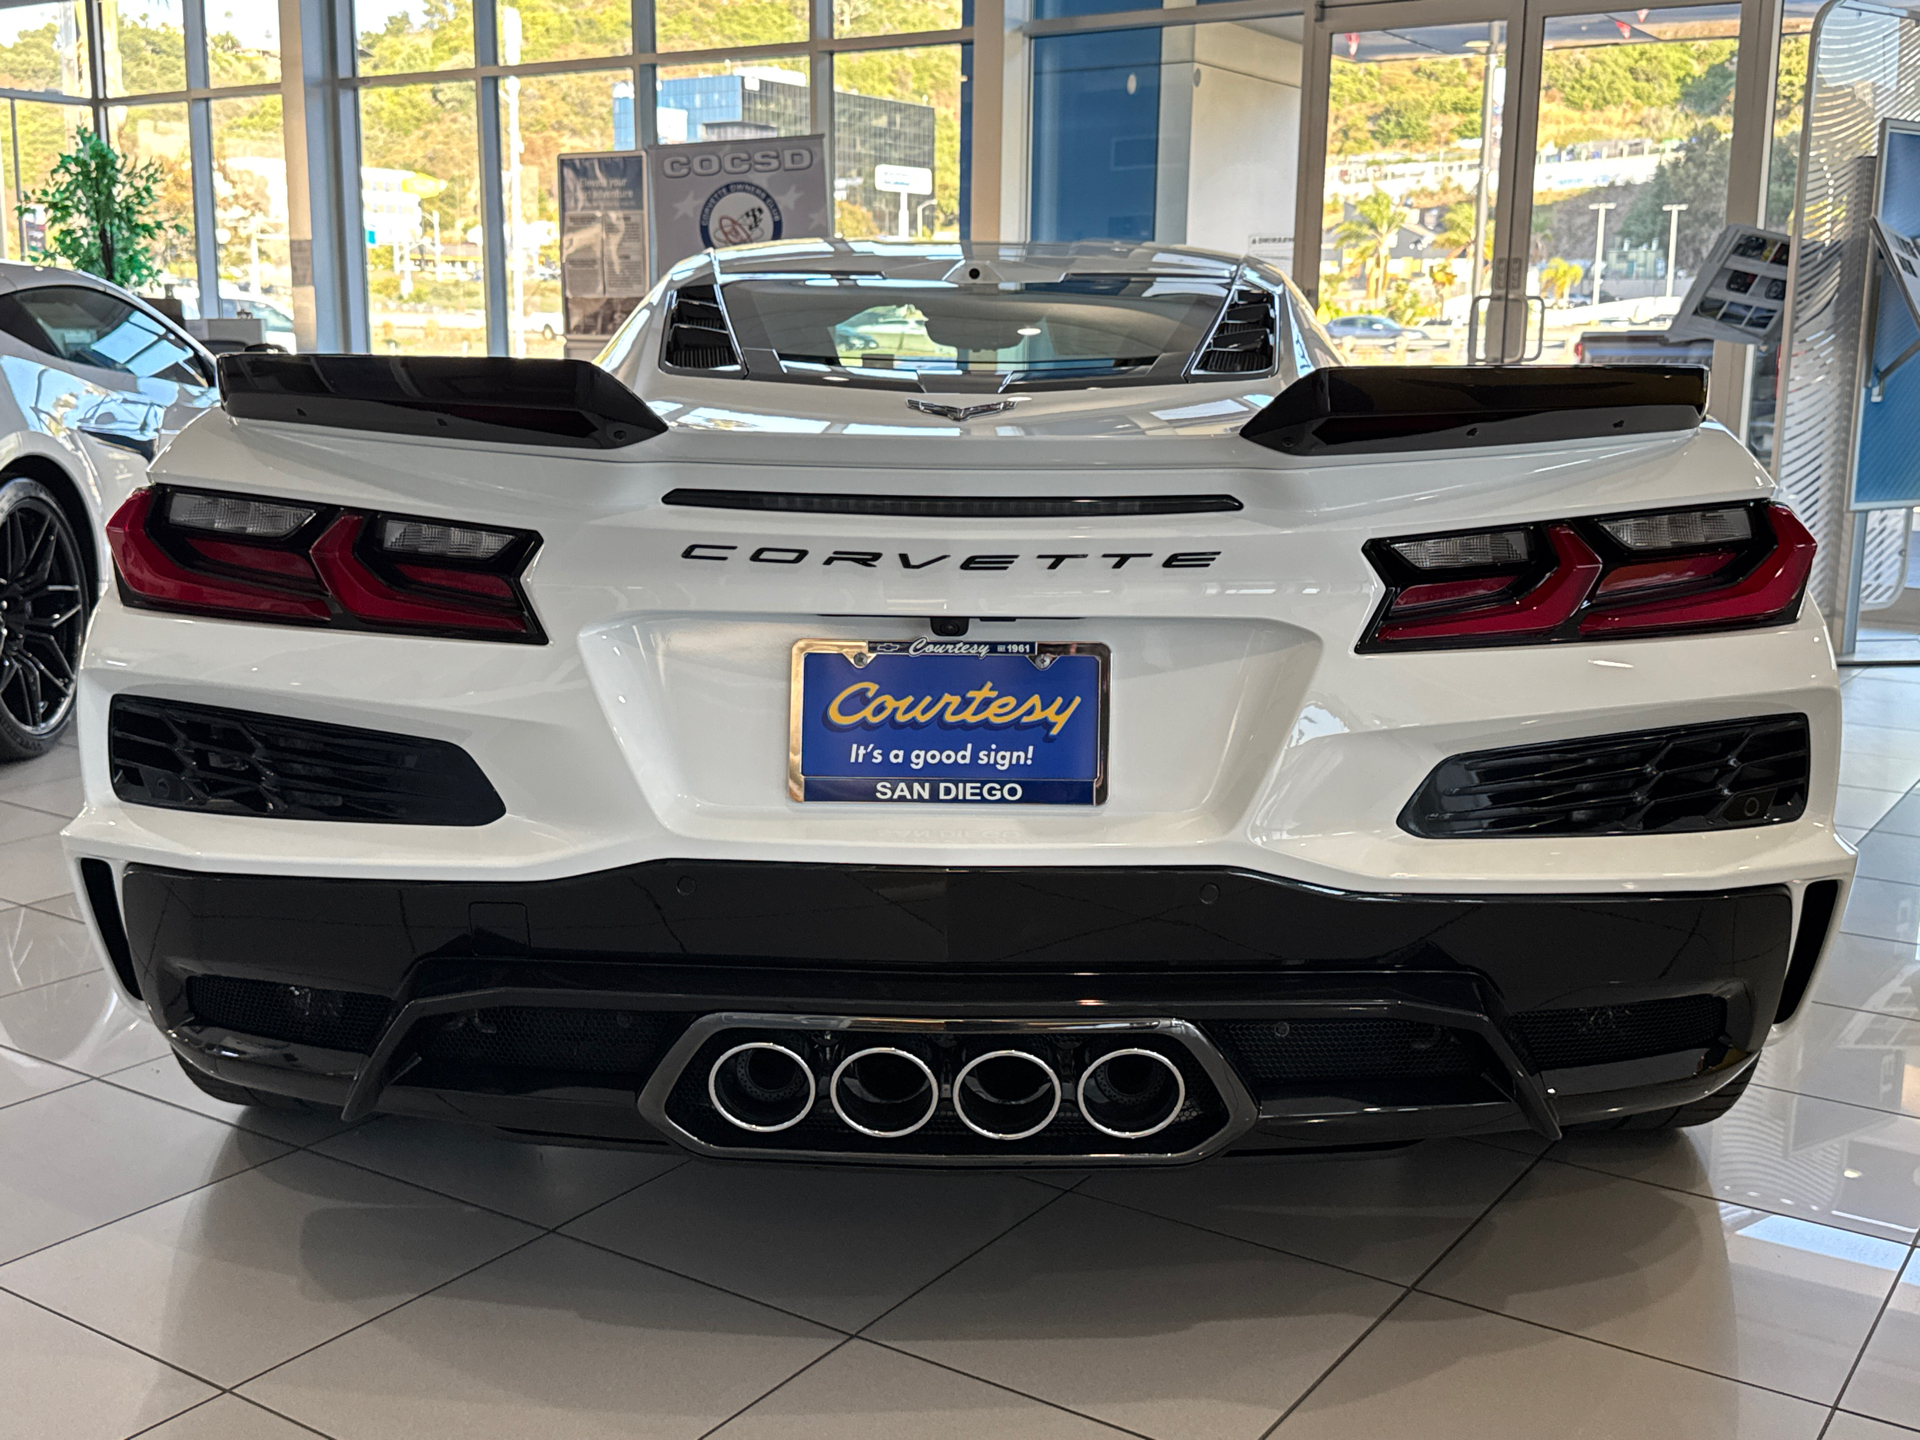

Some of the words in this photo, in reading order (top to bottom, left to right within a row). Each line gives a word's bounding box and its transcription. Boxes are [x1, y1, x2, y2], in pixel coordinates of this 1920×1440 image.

[663, 148, 813, 178] COCSD
[701, 187, 728, 226] CORVETTE
[729, 184, 767, 200] OWNERS
[766, 197, 781, 222] CLUB
[681, 543, 1222, 571] CORVETTE
[908, 636, 990, 658] Courtesy
[1007, 644, 1030, 653] 1961
[827, 680, 1082, 737] Courtesy
[849, 743, 883, 764] It's
[889, 748, 905, 765] a
[910, 744, 972, 769] good
[977, 745, 1035, 769] sign!
[875, 782, 929, 801] SAN
[938, 782, 1024, 802] DIEGO
